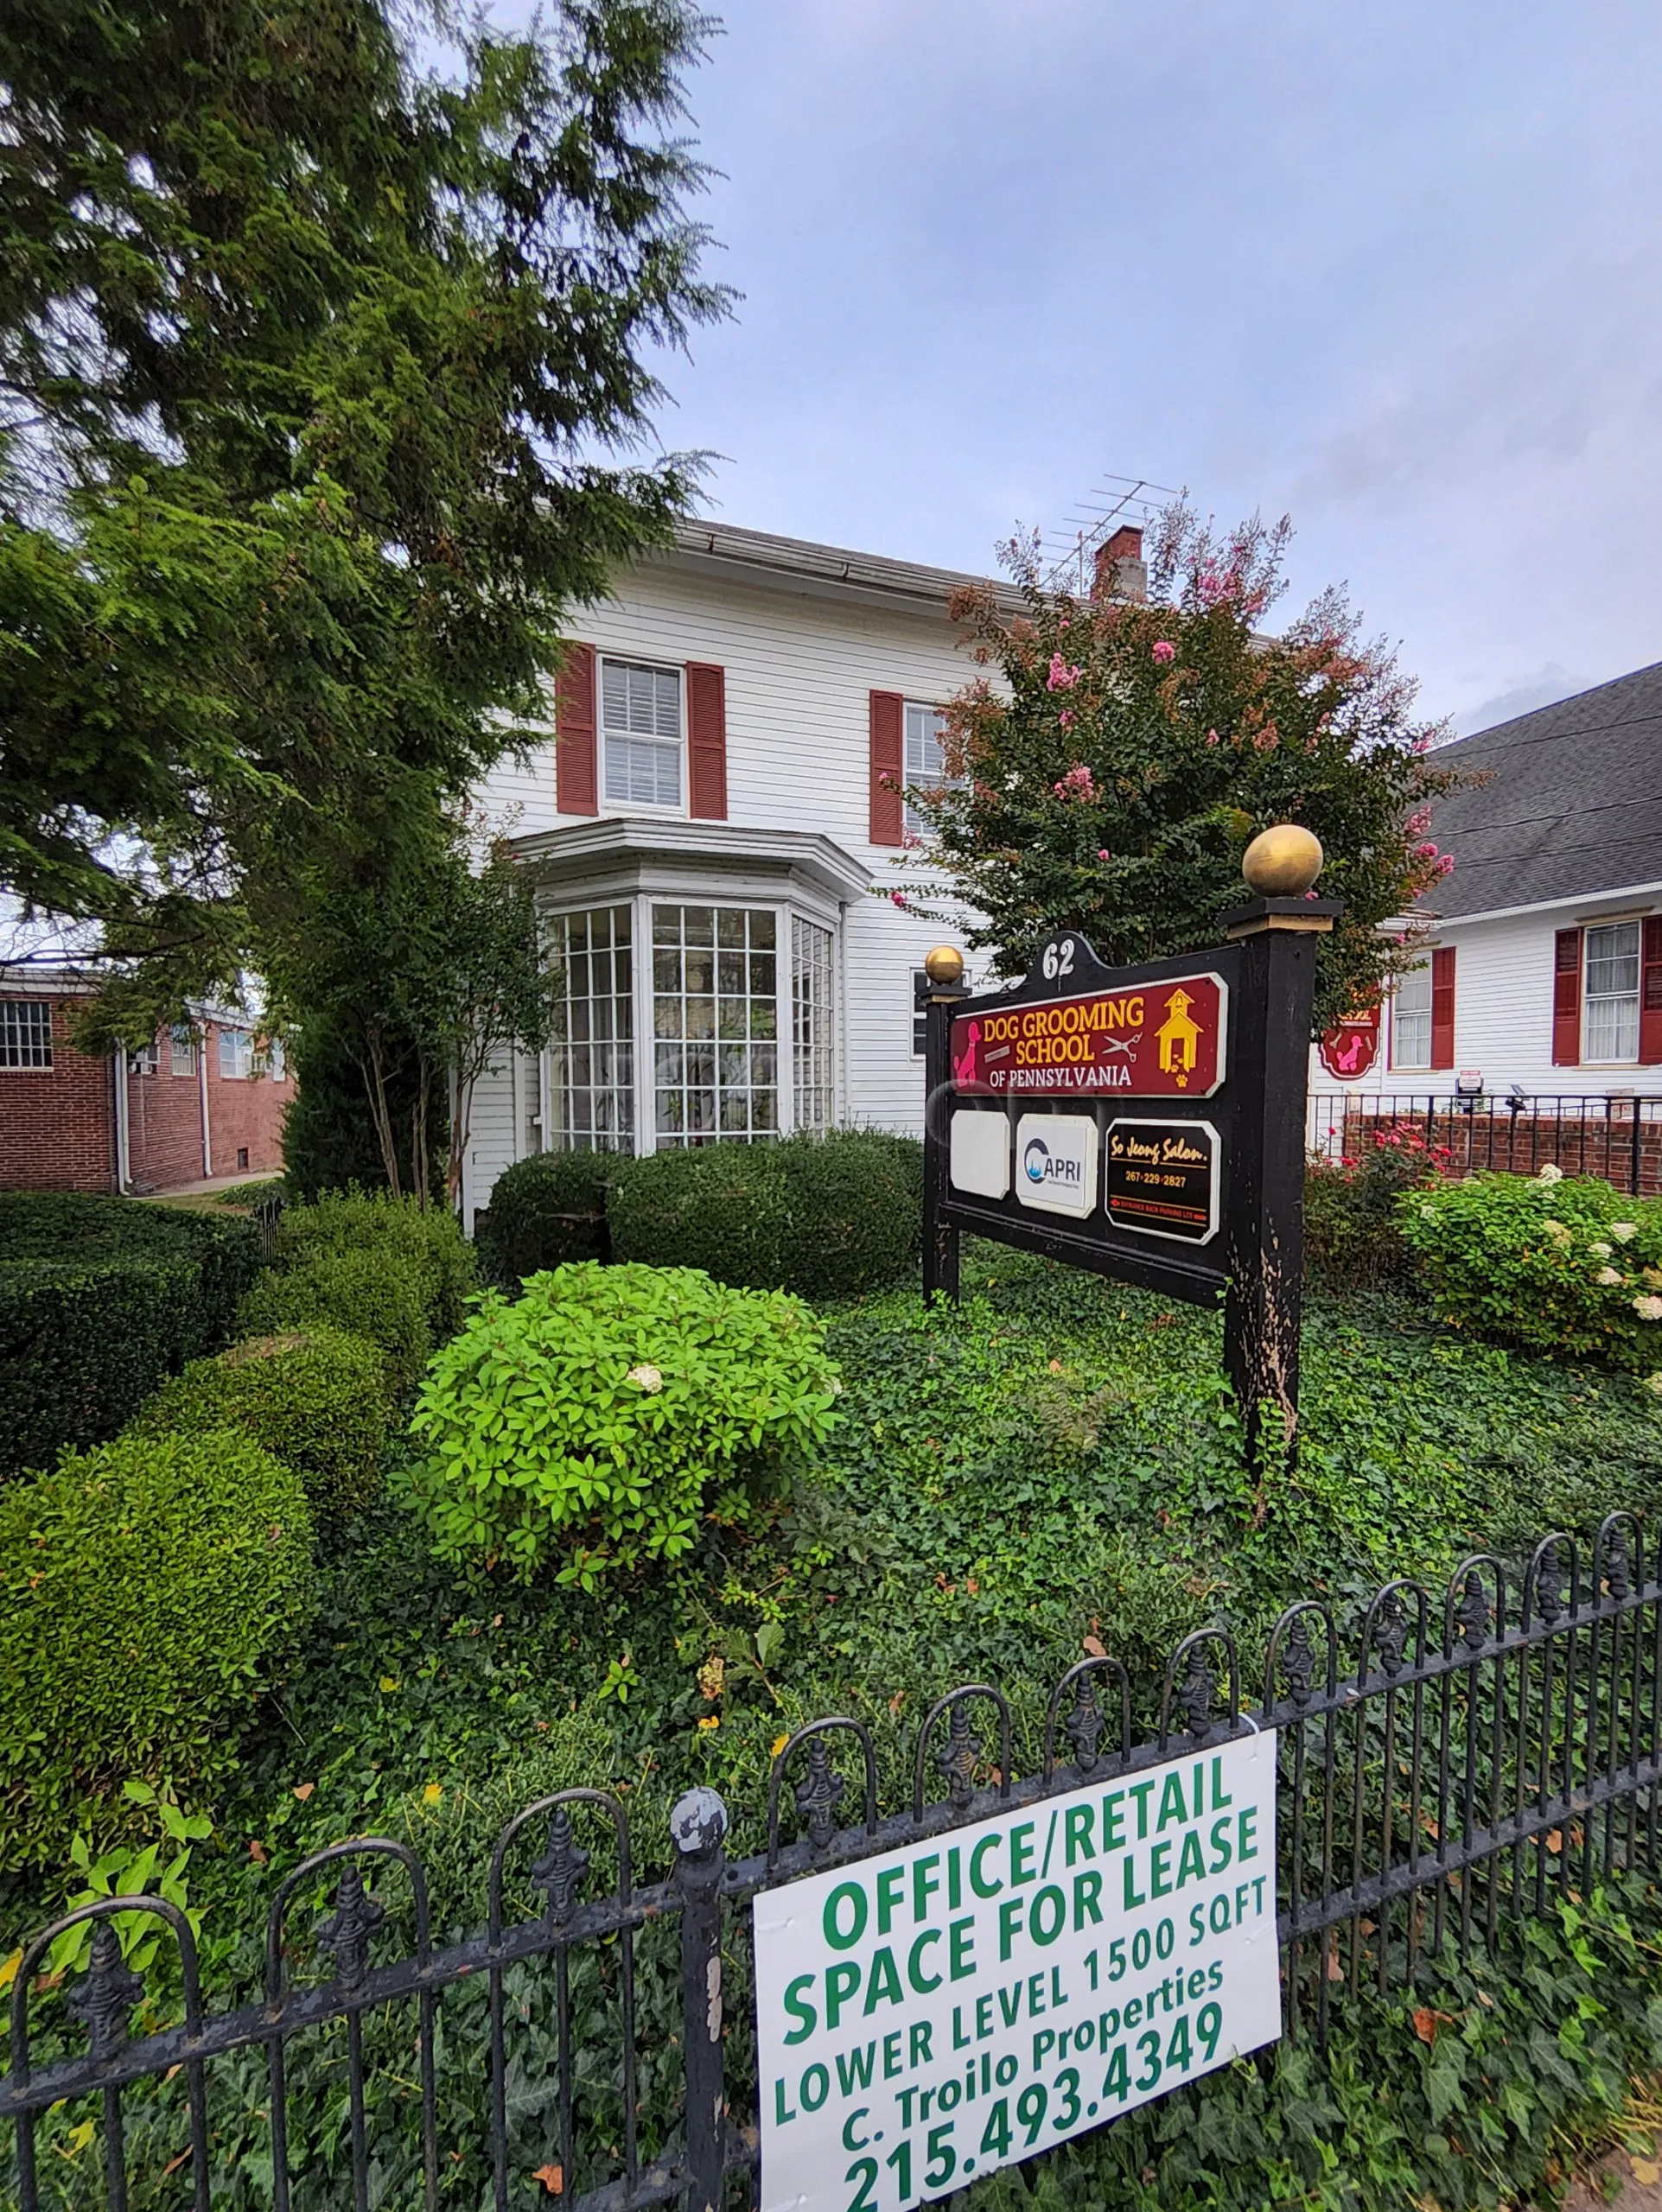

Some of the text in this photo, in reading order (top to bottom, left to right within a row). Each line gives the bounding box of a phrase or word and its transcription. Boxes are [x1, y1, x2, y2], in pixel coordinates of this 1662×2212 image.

[1042, 938, 1075, 980] 62
[984, 997, 1144, 1042] DOG GROOMING
[1016, 1034, 1095, 1065] SCHOOL
[990, 1065, 1132, 1088] OF PENNSYLVANIA
[1111, 1135, 1124, 1156] So
[1127, 1136, 1160, 1165] Jeong
[1183, 1211, 1194, 1219] LOT
[822, 1756, 1233, 1951] OFFICE/RETAIL
[782, 1806, 1258, 2045] SPACE FOR LEASE
[775, 1875, 1267, 2126] LOWER LEVEL 1500 SQFT
[842, 1960, 1224, 2152] C. Troilo Properties
[844, 2001, 1224, 2212] 215.493.4349
